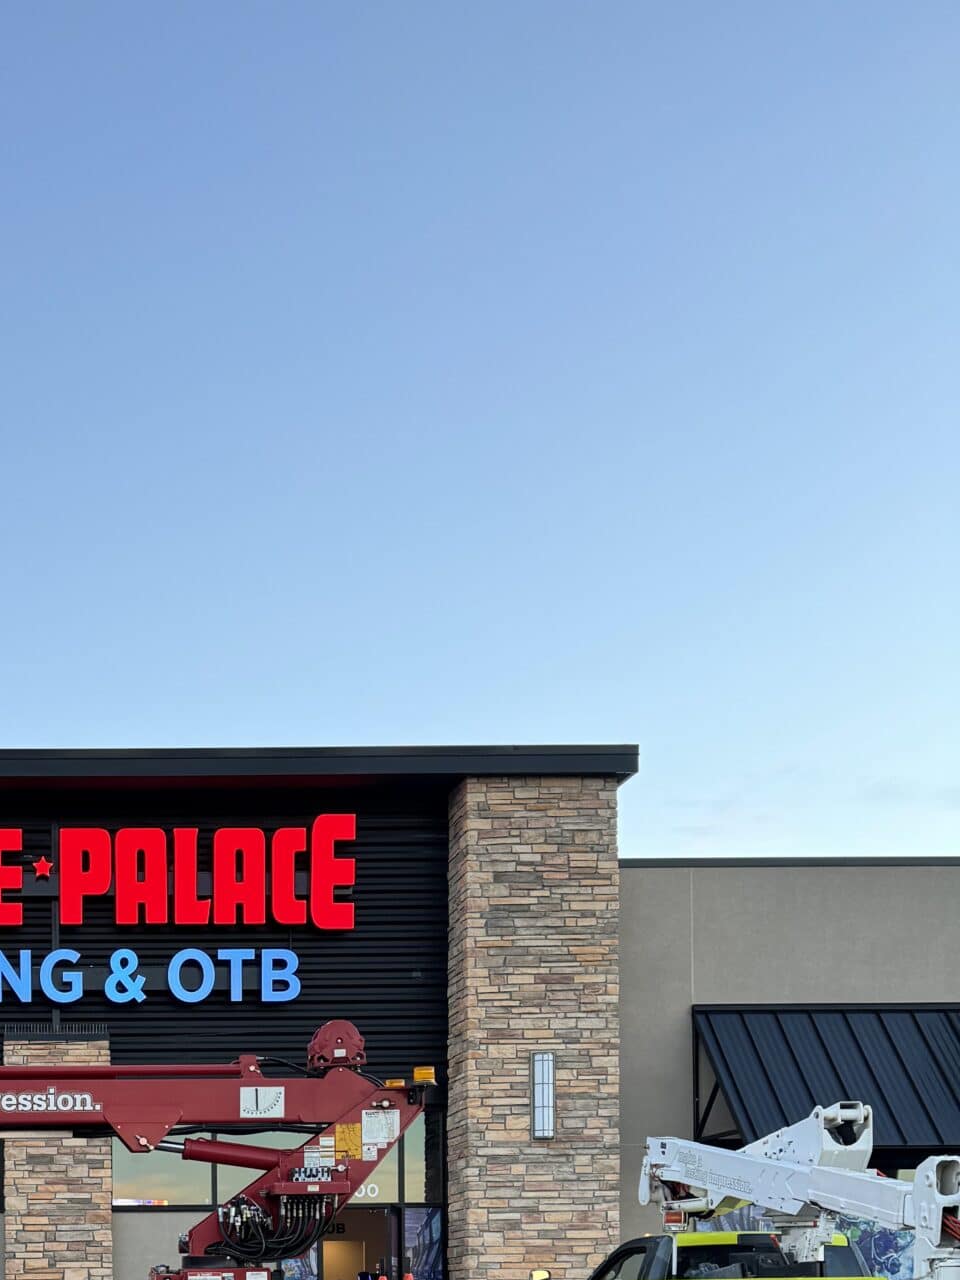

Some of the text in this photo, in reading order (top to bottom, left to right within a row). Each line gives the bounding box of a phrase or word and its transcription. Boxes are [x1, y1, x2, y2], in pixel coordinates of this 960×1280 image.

[59, 813, 357, 930] PALACE
[104, 948, 147, 1003] &
[167, 949, 302, 1003] OTB
